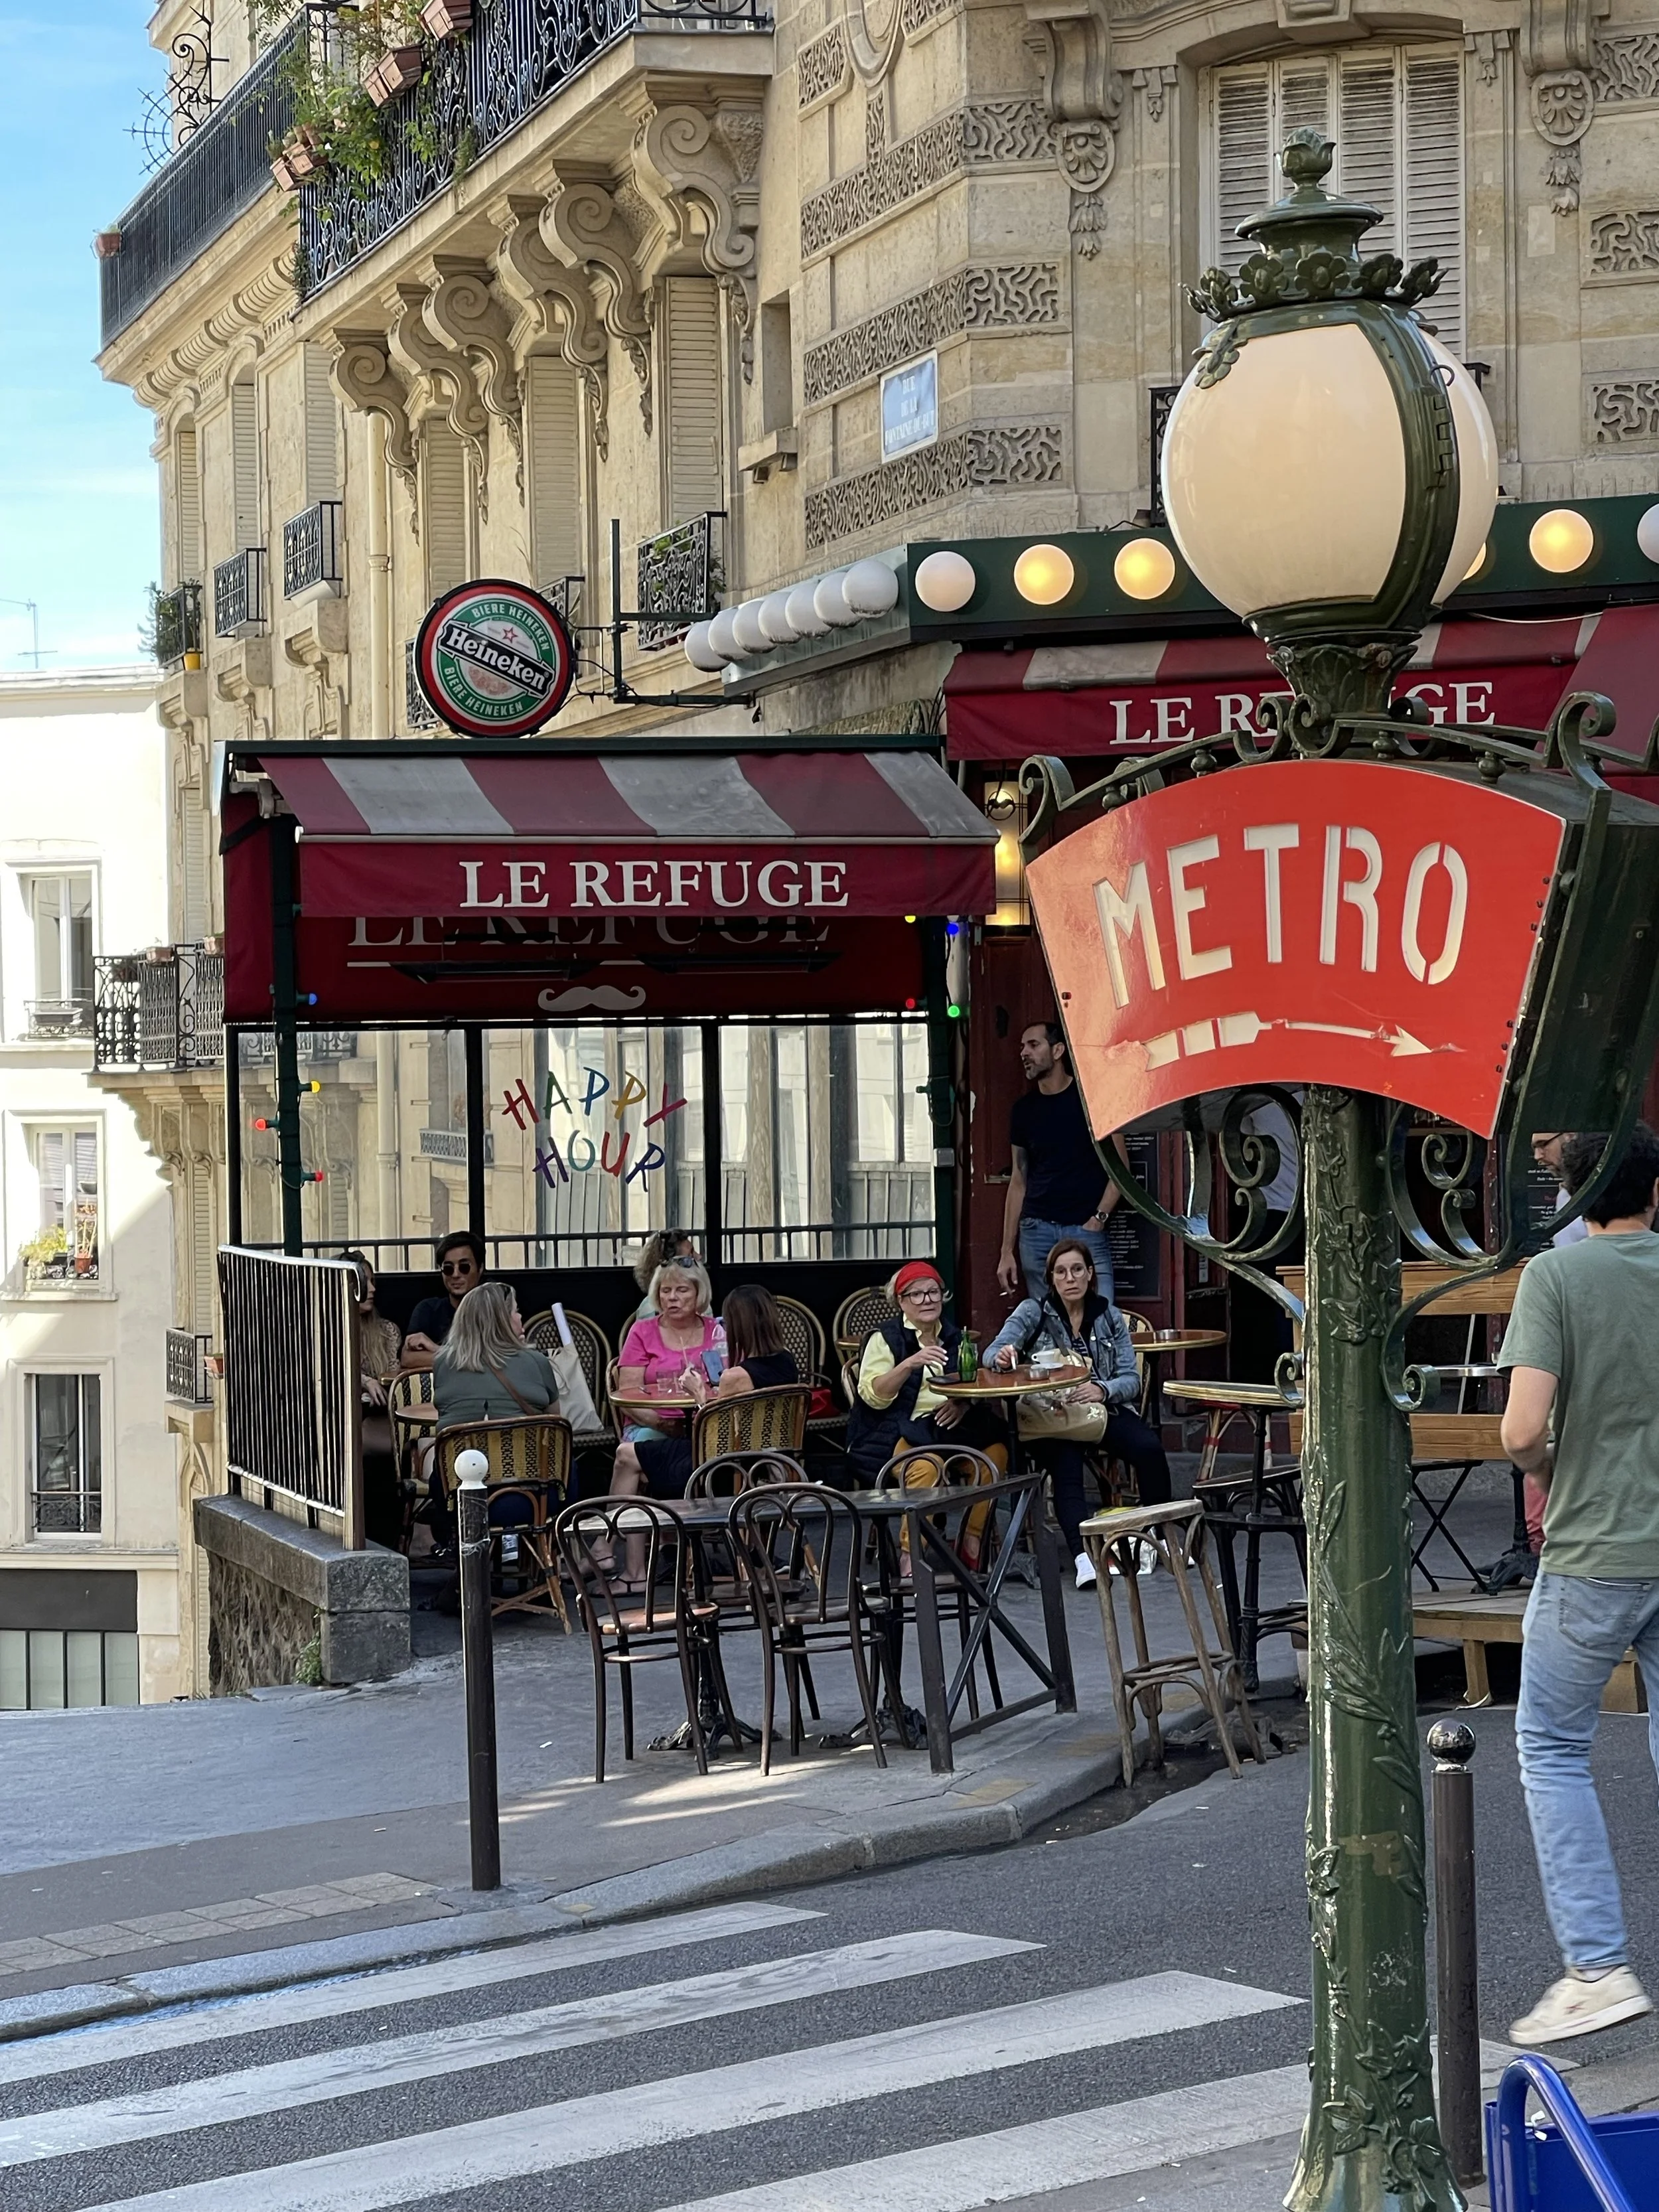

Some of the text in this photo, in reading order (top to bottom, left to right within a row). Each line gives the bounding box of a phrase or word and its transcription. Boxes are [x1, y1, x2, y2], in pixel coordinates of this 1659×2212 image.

[902, 376, 915, 395] RUE
[471, 603, 505, 618] BIERE
[509, 606, 549, 650] HEINEKEN
[447, 628, 546, 690] Heineken
[444, 667, 523, 716] BIERE HEINEKEN
[1110, 698, 1194, 745] LE
[459, 860, 849, 909] LE REFUGE
[1092, 823, 1468, 1009] METRO
[502, 1067, 687, 1130] HAPPY
[532, 1130, 665, 1192] HOUR
